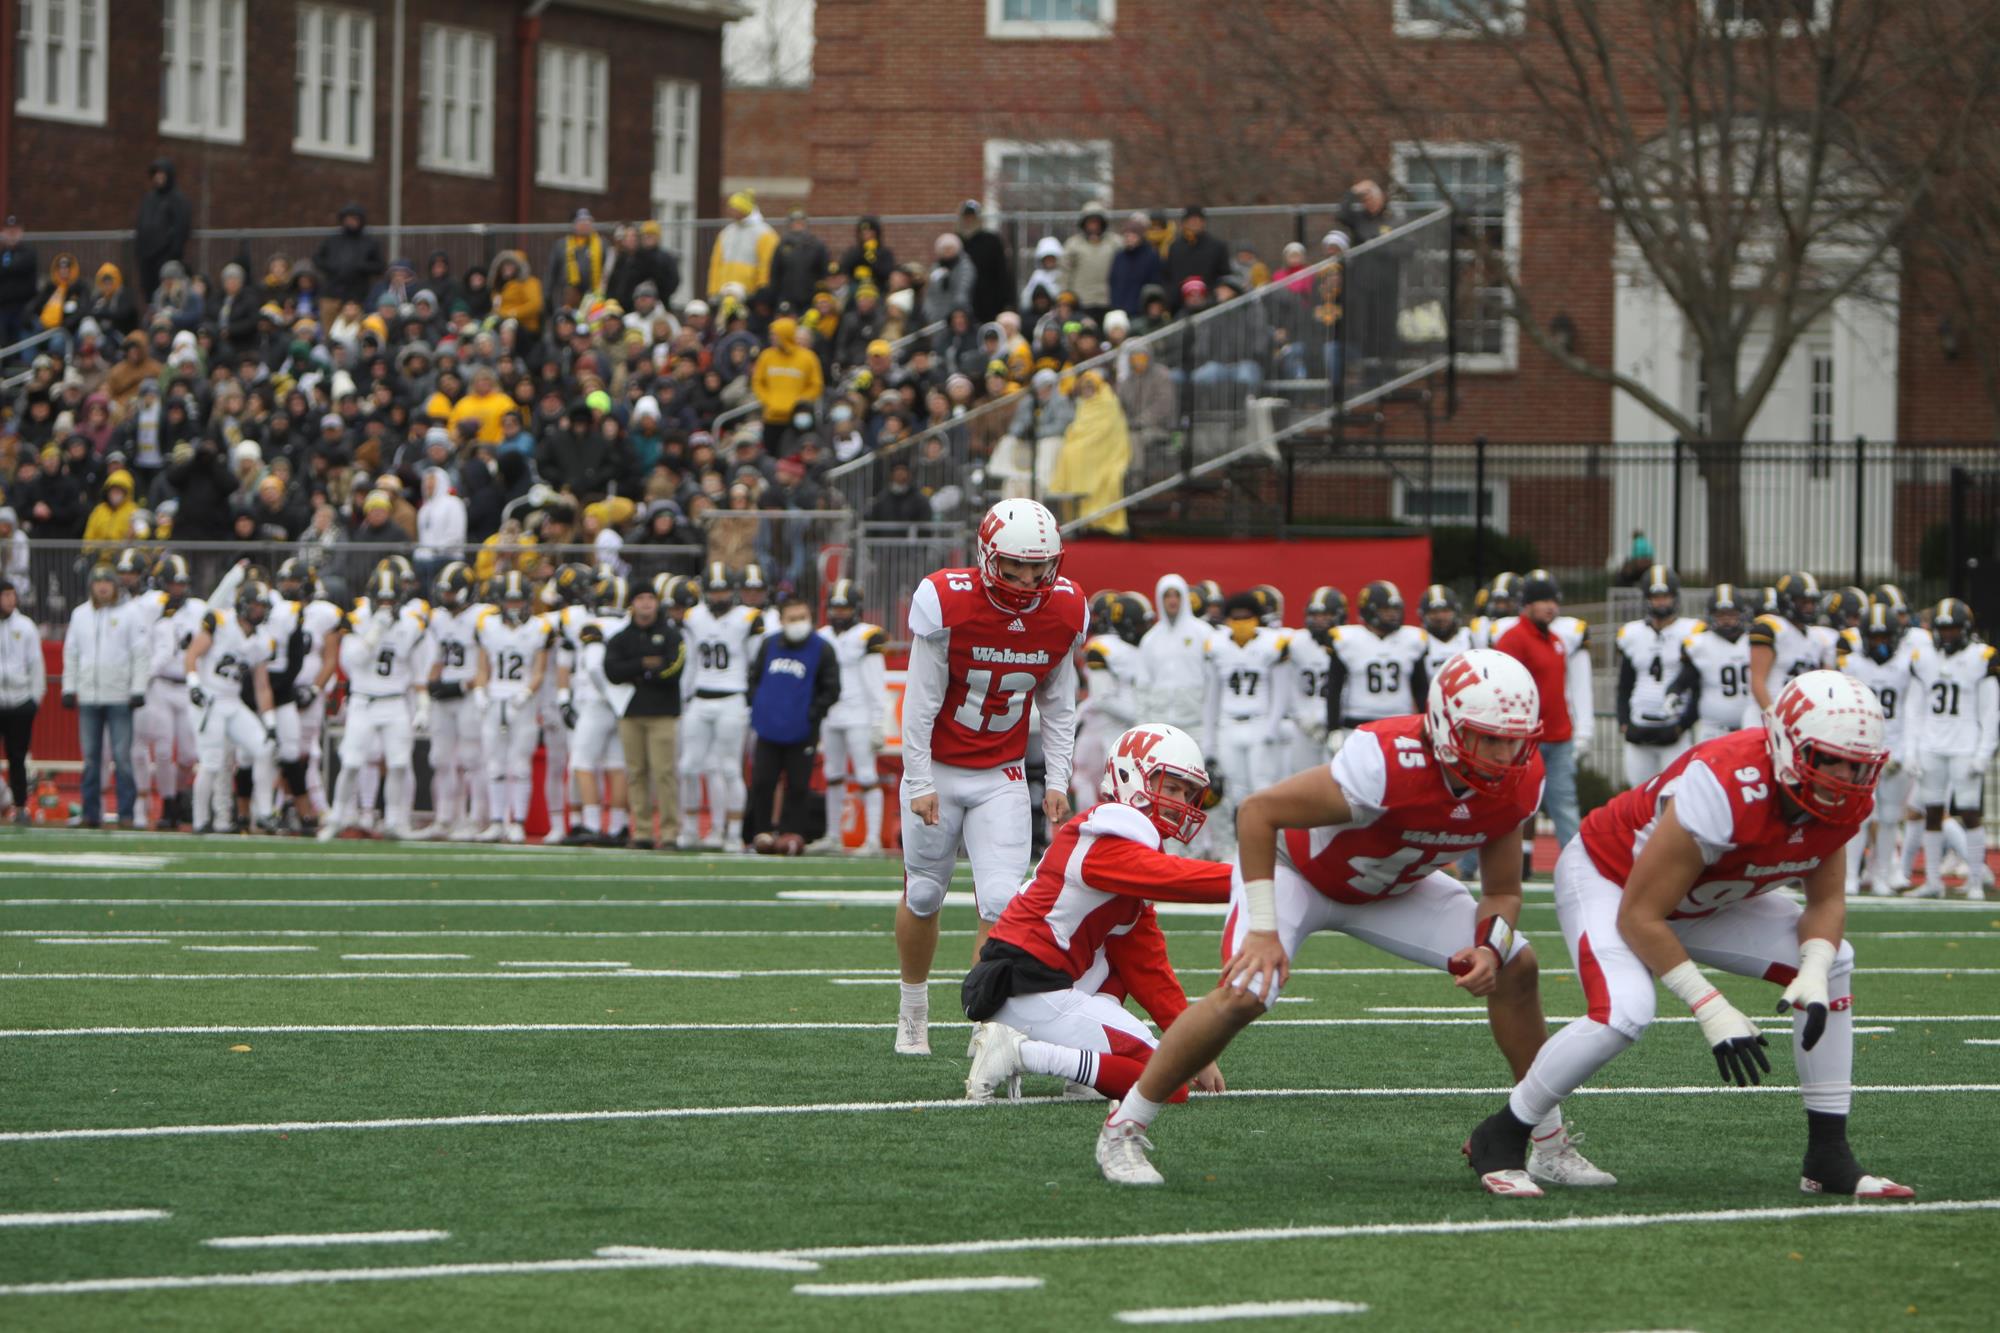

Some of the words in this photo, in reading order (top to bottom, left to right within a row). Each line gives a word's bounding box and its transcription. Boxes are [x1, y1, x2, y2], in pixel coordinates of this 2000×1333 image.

[946, 572, 973, 592] 13
[377, 650, 394, 676] 5
[497, 652, 523, 681] 12
[972, 646, 1050, 665] Wabash
[1648, 655, 1663, 682] 4
[1228, 671, 1259, 696] 47
[1367, 662, 1400, 694] 63
[953, 668, 1037, 732] 13
[1931, 682, 1960, 716] 31
[1393, 735, 1427, 769] 45
[1734, 766, 1769, 805] 92
